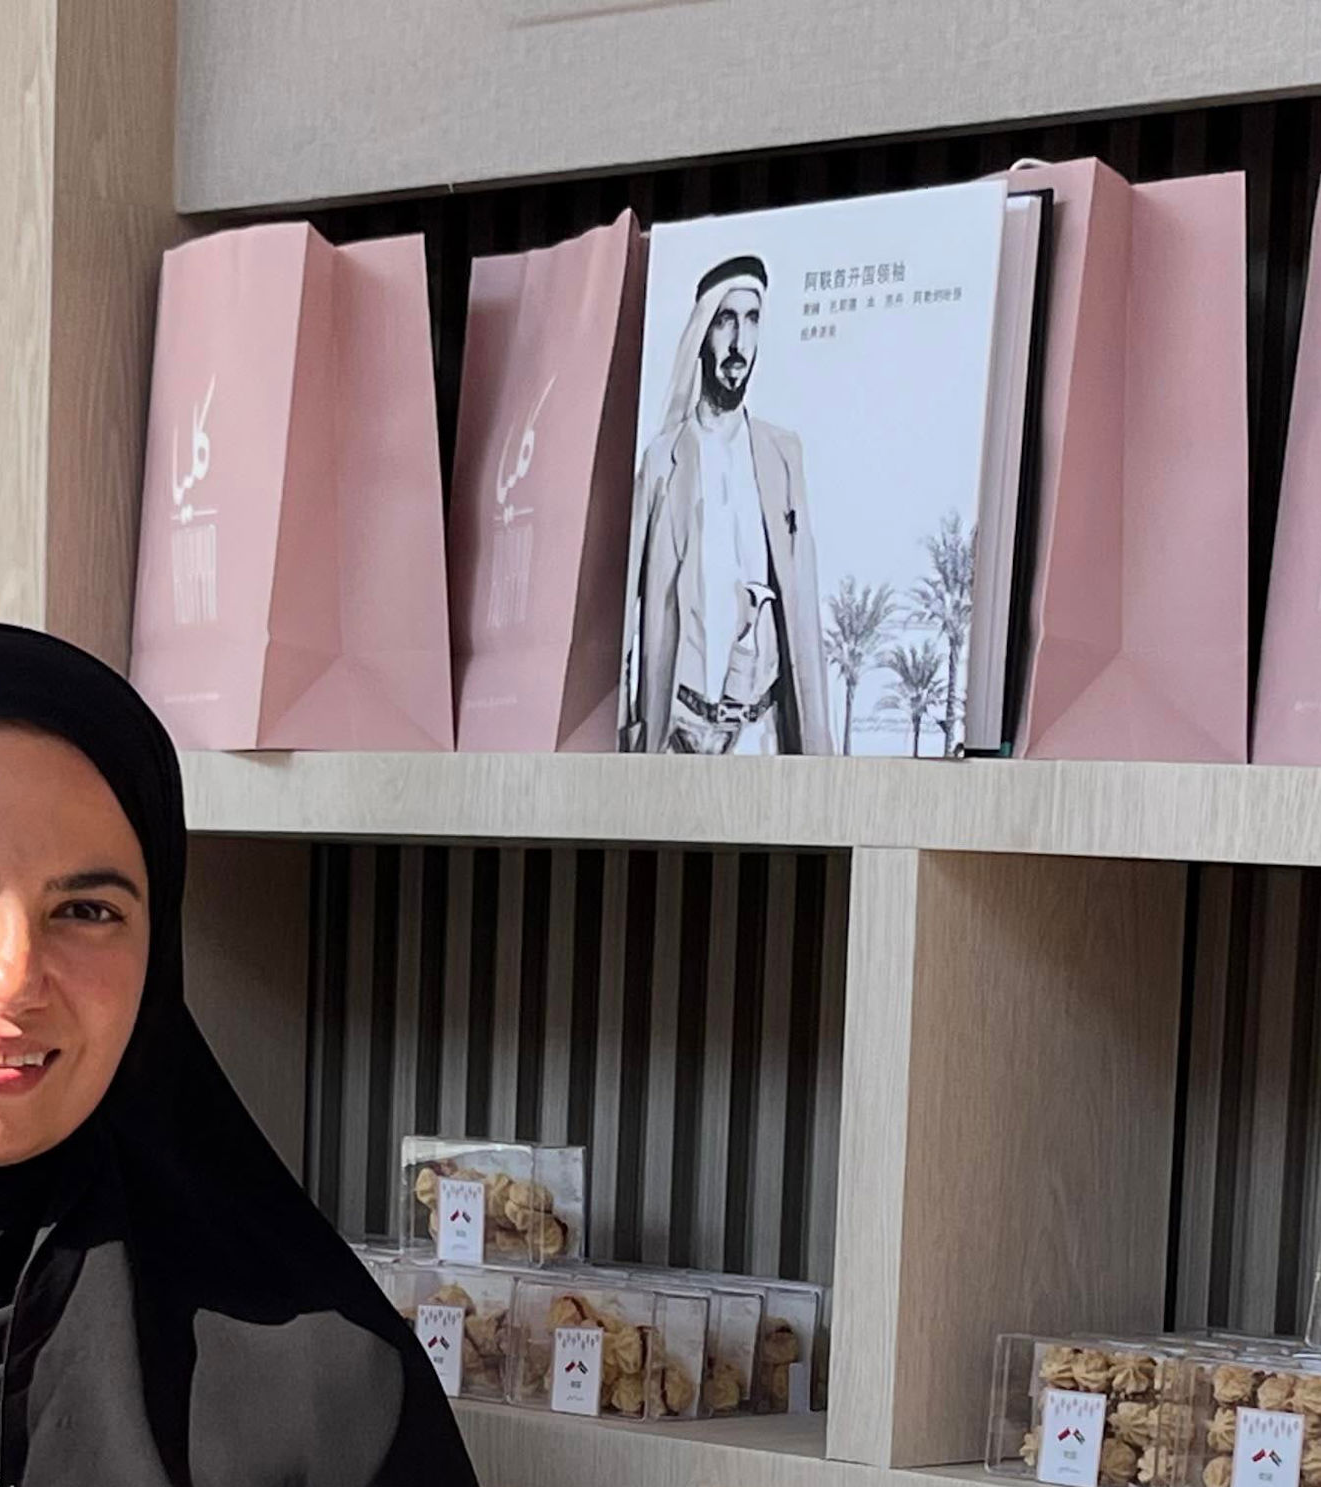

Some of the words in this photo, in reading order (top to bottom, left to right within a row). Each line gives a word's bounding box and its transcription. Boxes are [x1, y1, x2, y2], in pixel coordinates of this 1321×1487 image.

[804, 260, 906, 292] 阿联酋开国领袖
